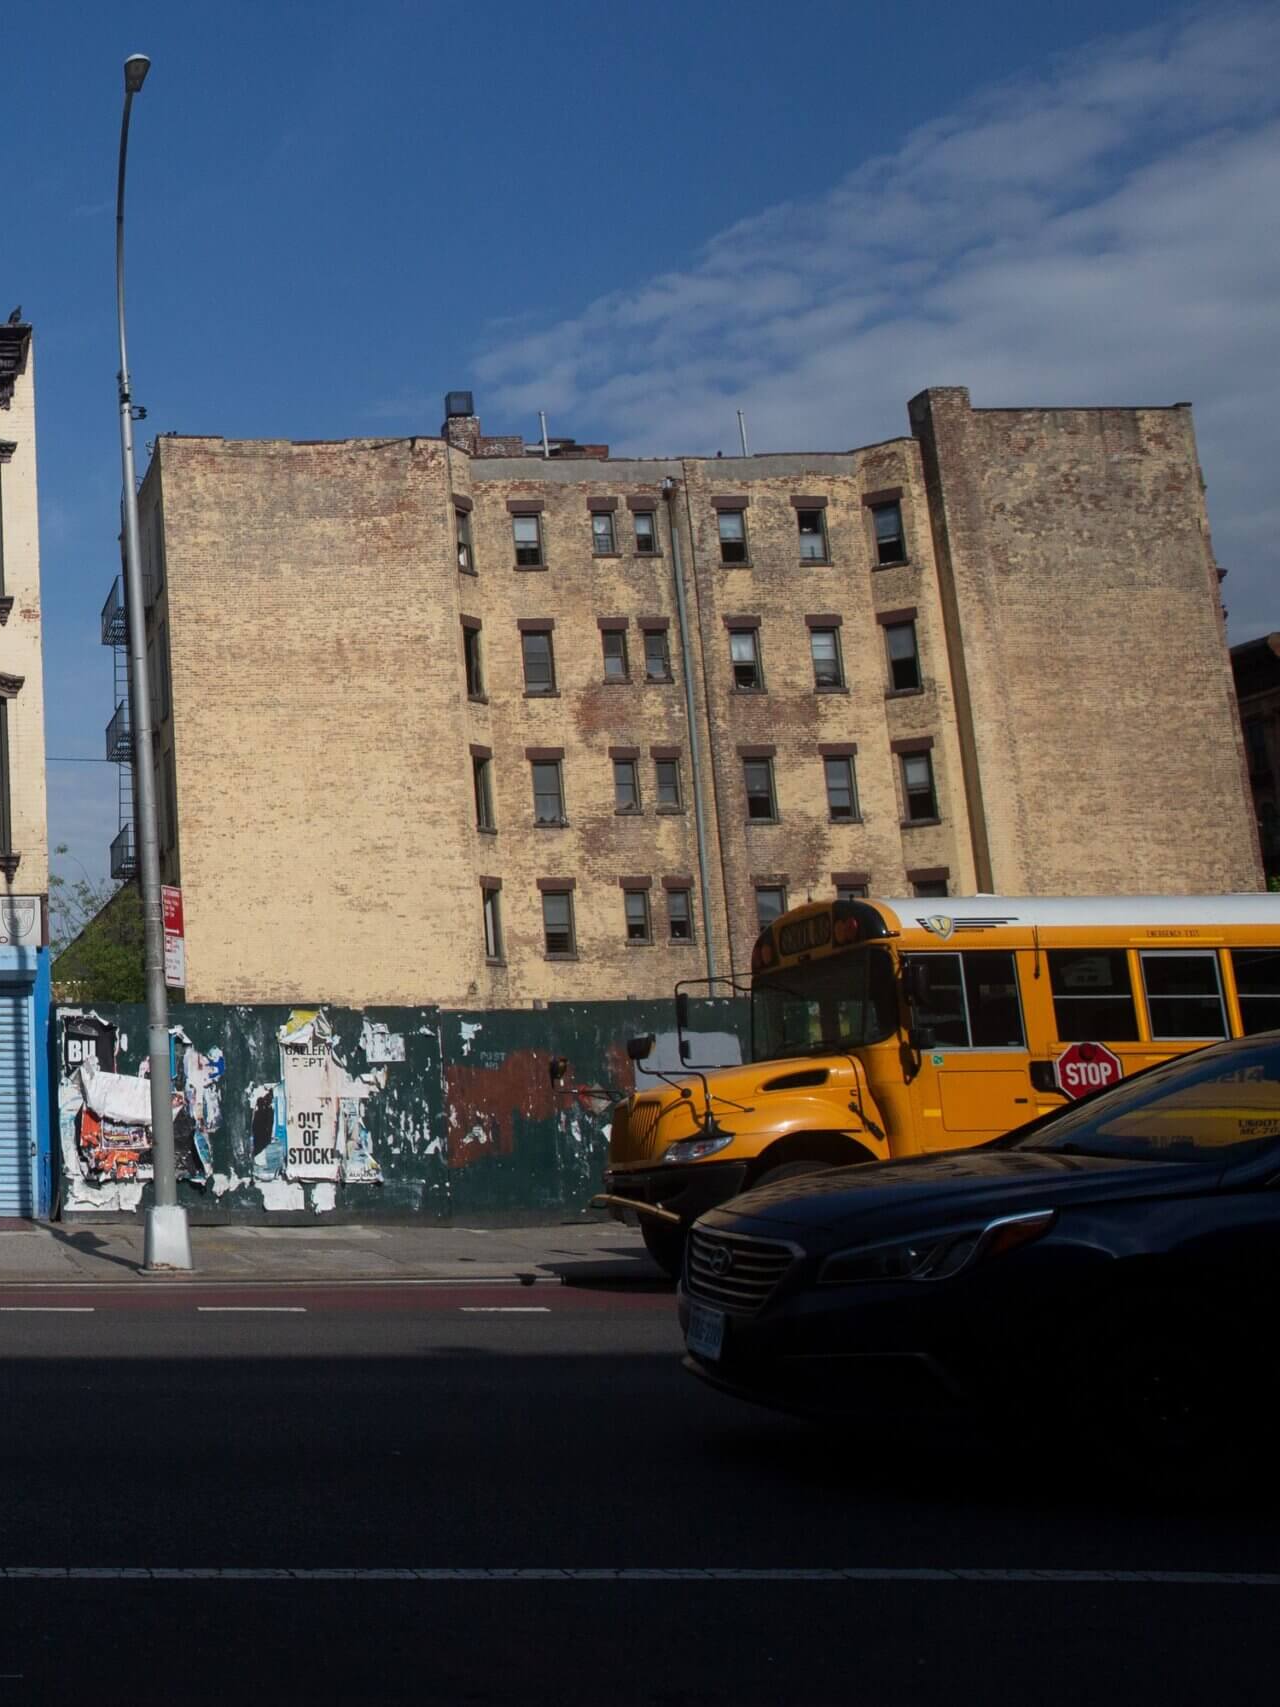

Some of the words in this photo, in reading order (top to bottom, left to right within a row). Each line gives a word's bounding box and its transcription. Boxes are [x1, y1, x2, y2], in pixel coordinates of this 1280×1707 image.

[285, 1045, 332, 1056] GALLERY
[1065, 1062, 1112, 1086] STOP
[297, 1111, 324, 1129] OUT
[303, 1130, 319, 1147] OF
[288, 1147, 335, 1165] STOCK!
